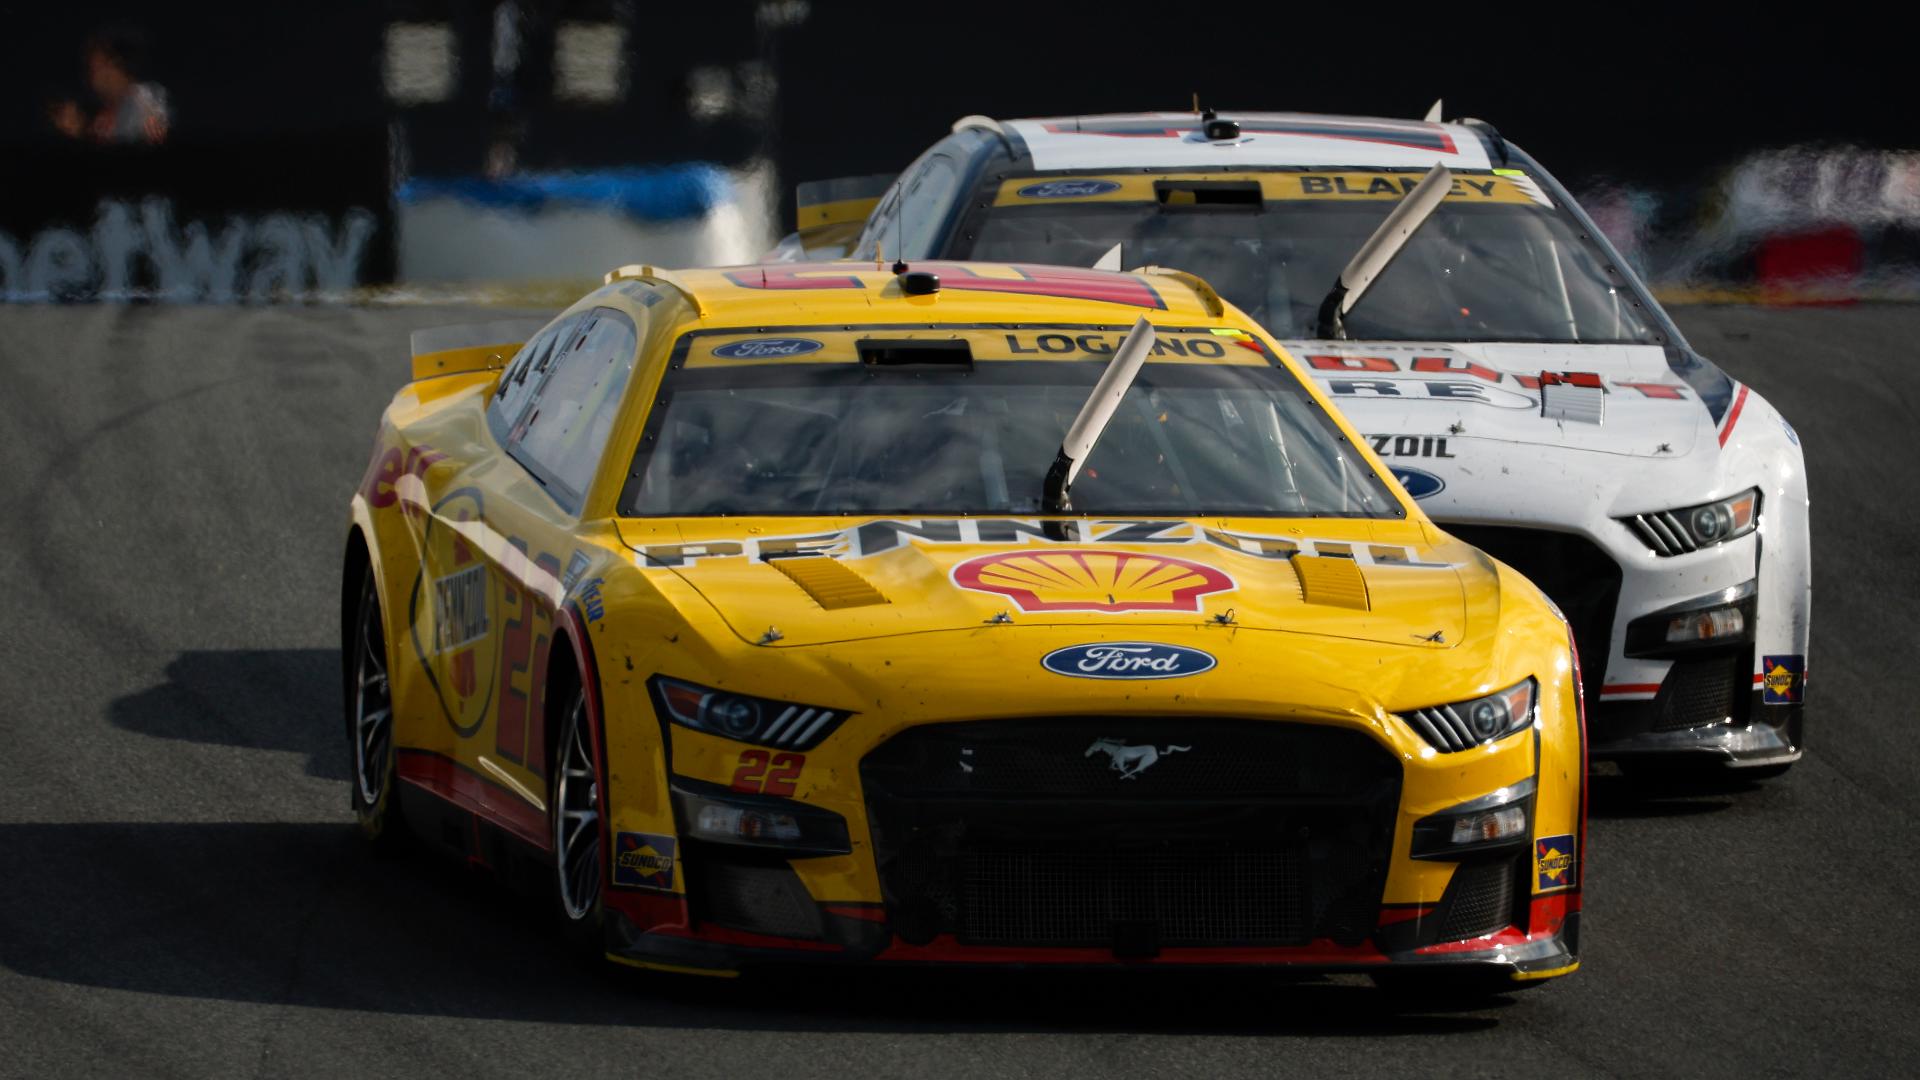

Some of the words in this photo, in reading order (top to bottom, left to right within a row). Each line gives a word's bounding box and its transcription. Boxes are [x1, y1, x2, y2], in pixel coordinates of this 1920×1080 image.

[734, 341, 801, 357] Ford
[1006, 334, 1226, 358] LOGNO
[1362, 435, 1456, 458] ZOIL
[1078, 646, 1180, 672] Ford
[732, 750, 806, 797] 22
[619, 852, 672, 871] SUNOCO
